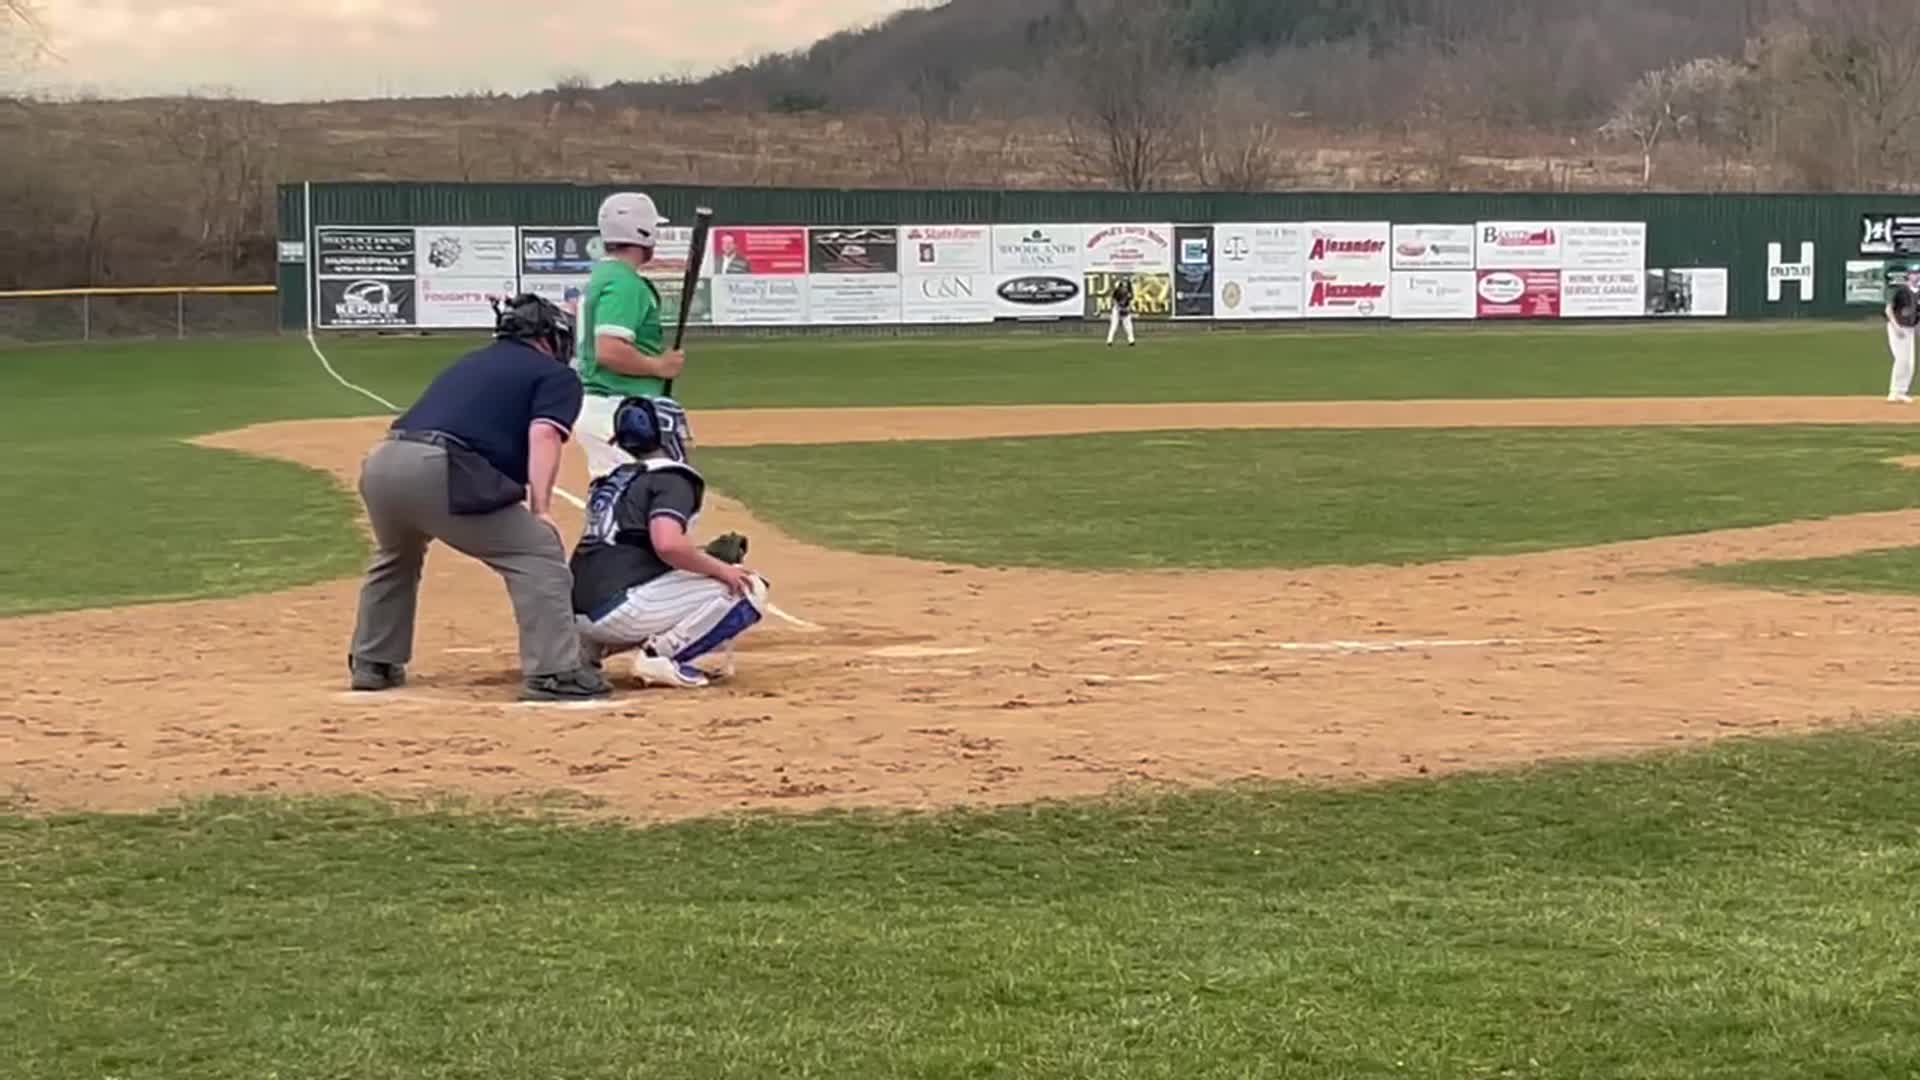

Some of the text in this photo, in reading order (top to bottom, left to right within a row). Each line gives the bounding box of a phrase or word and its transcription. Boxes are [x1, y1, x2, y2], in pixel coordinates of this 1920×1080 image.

[1309, 238, 1386, 260] Alexander
[922, 275, 973, 297] C&N
[1309, 282, 1386, 306] Alexander
